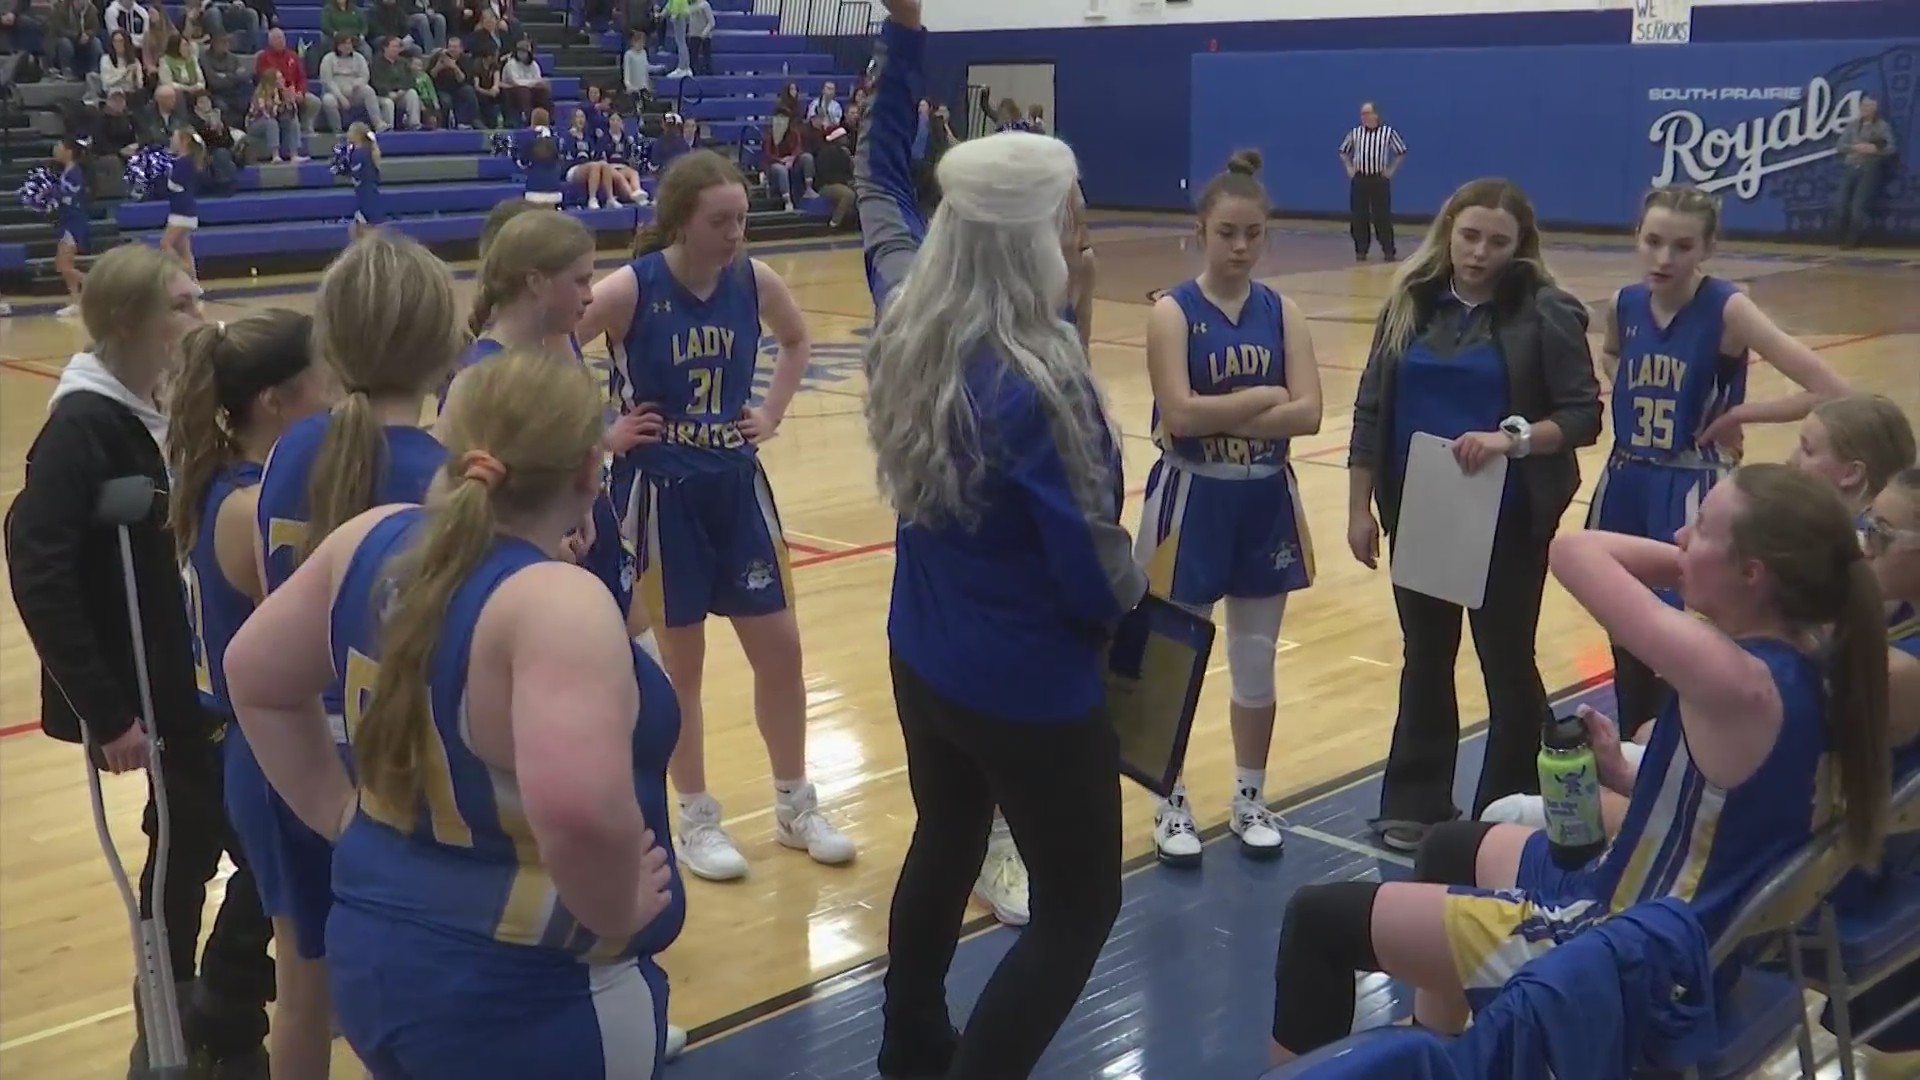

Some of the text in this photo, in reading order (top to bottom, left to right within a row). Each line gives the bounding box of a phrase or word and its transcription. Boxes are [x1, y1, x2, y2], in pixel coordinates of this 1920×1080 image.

[1636, 0, 1657, 18] WE
[1636, 21, 1688, 40] SENIORS
[1649, 86, 1803, 100] SOUTH PRAIRIE
[1649, 76, 1862, 199] Royals
[671, 325, 735, 366] LADY
[1208, 343, 1271, 386] LADY
[686, 367, 723, 415] 31
[1627, 353, 1687, 392] LADY
[1631, 396, 1676, 450] 35
